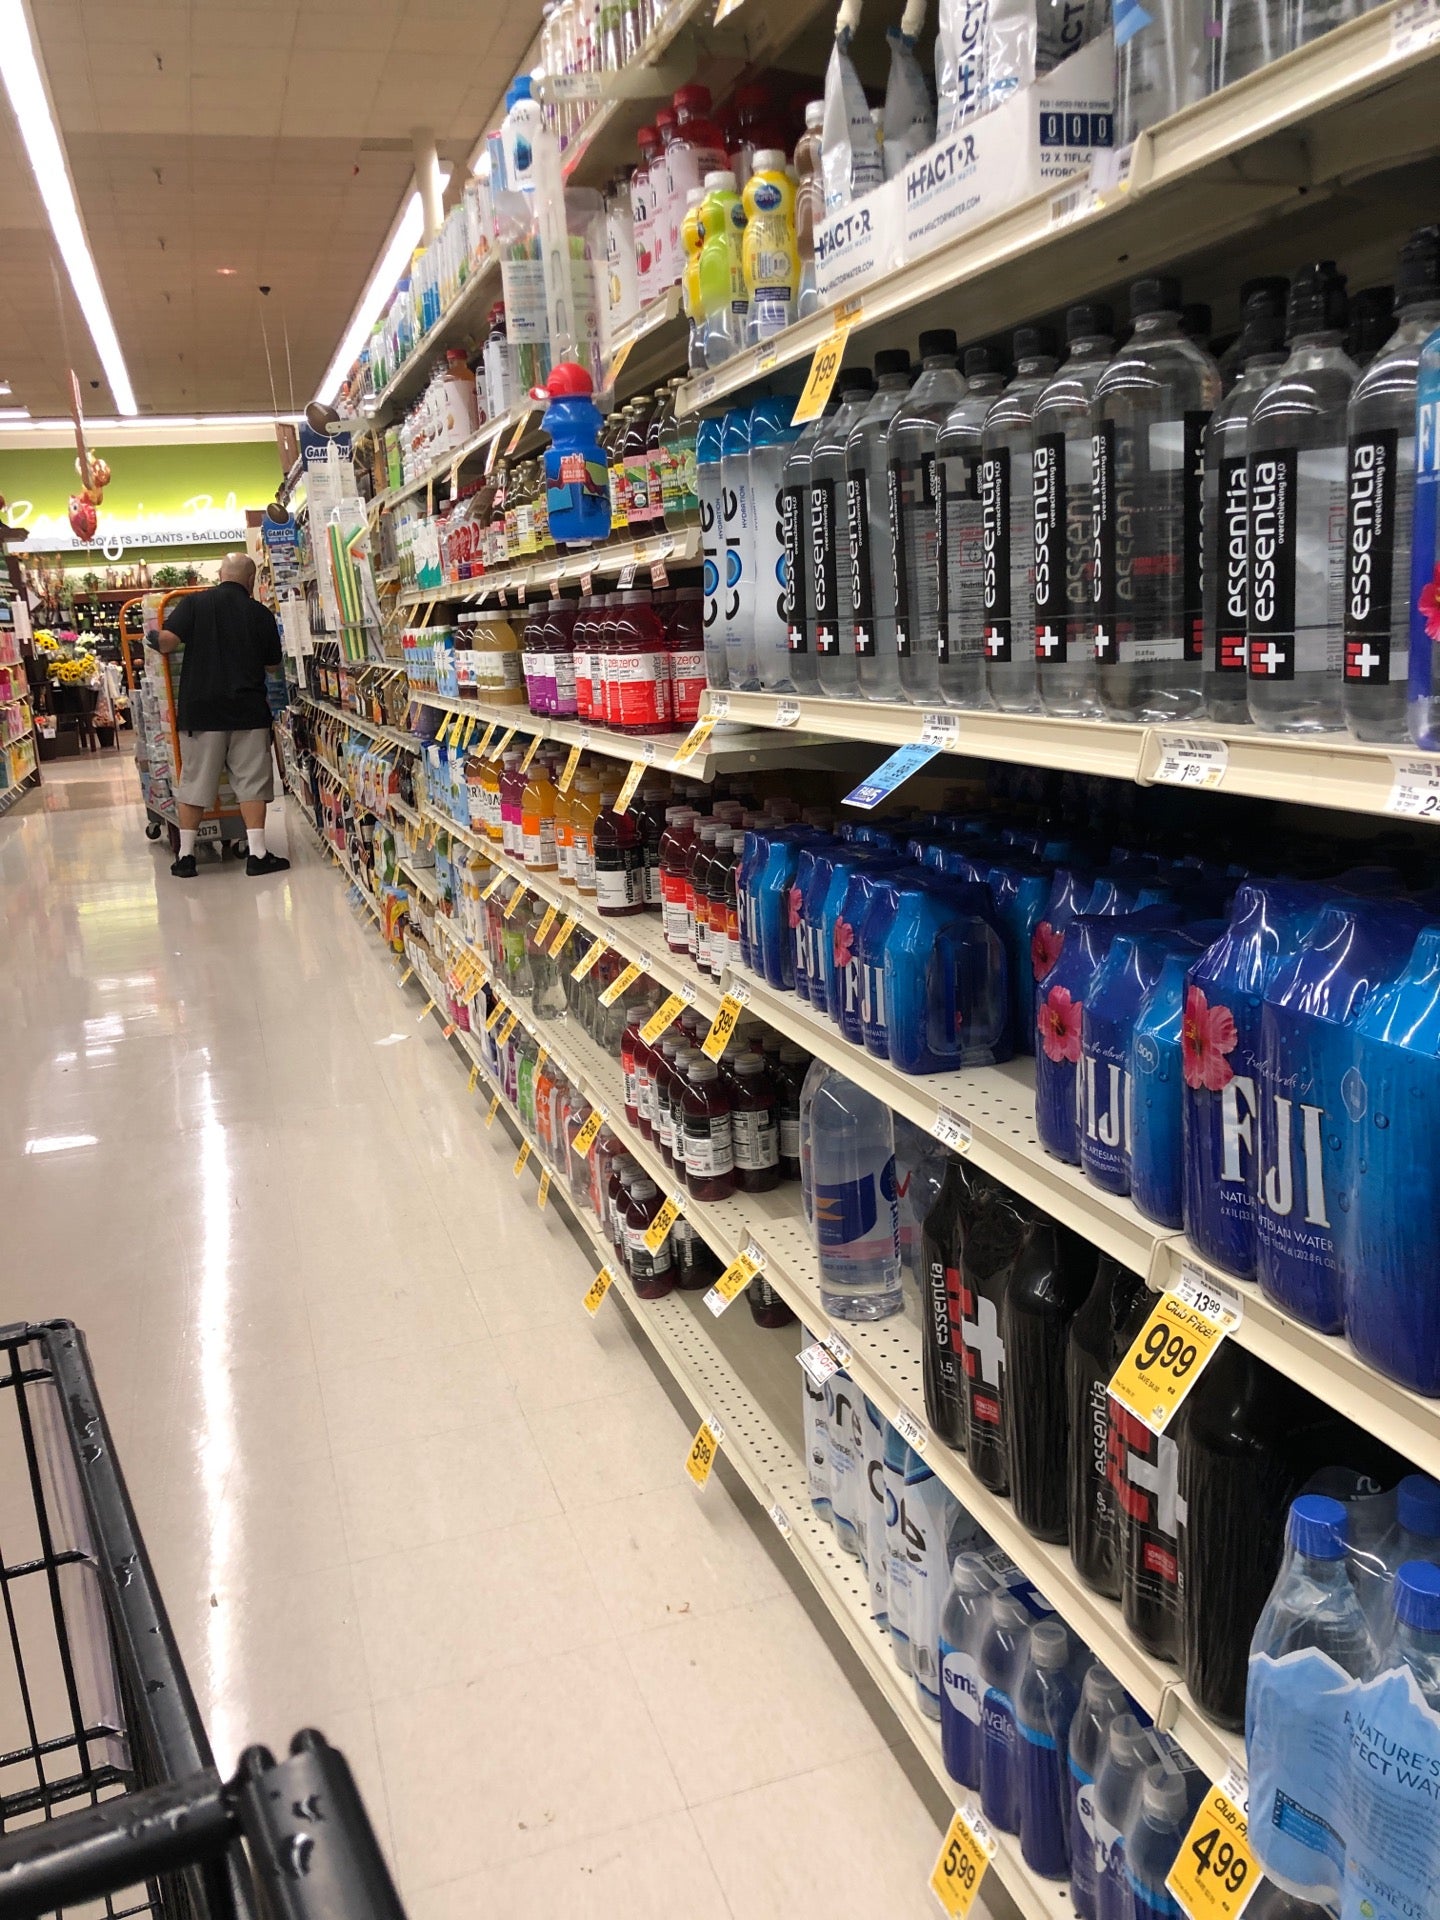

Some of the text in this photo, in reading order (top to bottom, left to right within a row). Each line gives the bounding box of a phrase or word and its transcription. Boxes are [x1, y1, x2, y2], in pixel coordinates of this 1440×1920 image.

[1048, 115, 1107, 138] 0 0 0
[1040, 153, 1049, 163] 12
[1054, 154, 1061, 163] X
[810, 352, 837, 395] 199
[739, 485, 747, 529] HYDRATION
[1033, 447, 1050, 606] essentia
[1278, 481, 1288, 545] overachieving
[1374, 466, 1386, 536] overachieving
[142, 533, 183, 544] PLANTS
[784, 495, 796, 611] essentia
[811, 488, 826, 612] essentia
[847, 480, 861, 610] essentia
[983, 460, 996, 609] essentia
[1225, 468, 1247, 618] essentia
[1252, 461, 1276, 622] essentia
[1351, 444, 1375, 621] essentia
[620, 658, 640, 668] zero
[677, 655, 701, 665] zero
[653, 655, 665, 720] vitaminwater
[713, 1009, 734, 1036] 399
[1220, 1075, 1331, 1229] FJI
[651, 1209, 671, 1231] 599
[1294, 1231, 1334, 1253] WATER
[935, 1262, 944, 1346] essentia
[1165, 1300, 1219, 1340] Club Price!
[1193, 1291, 1221, 1313] 1399
[1135, 1323, 1197, 1378] 999
[1137, 1372, 1150, 1386] SAVE
[692, 1436, 711, 1465] 599
[1094, 1379, 1107, 1477] essentia
[1214, 1797, 1237, 1826] Club
[944, 1838, 976, 1890] 599
[1191, 1827, 1248, 1893] 499
